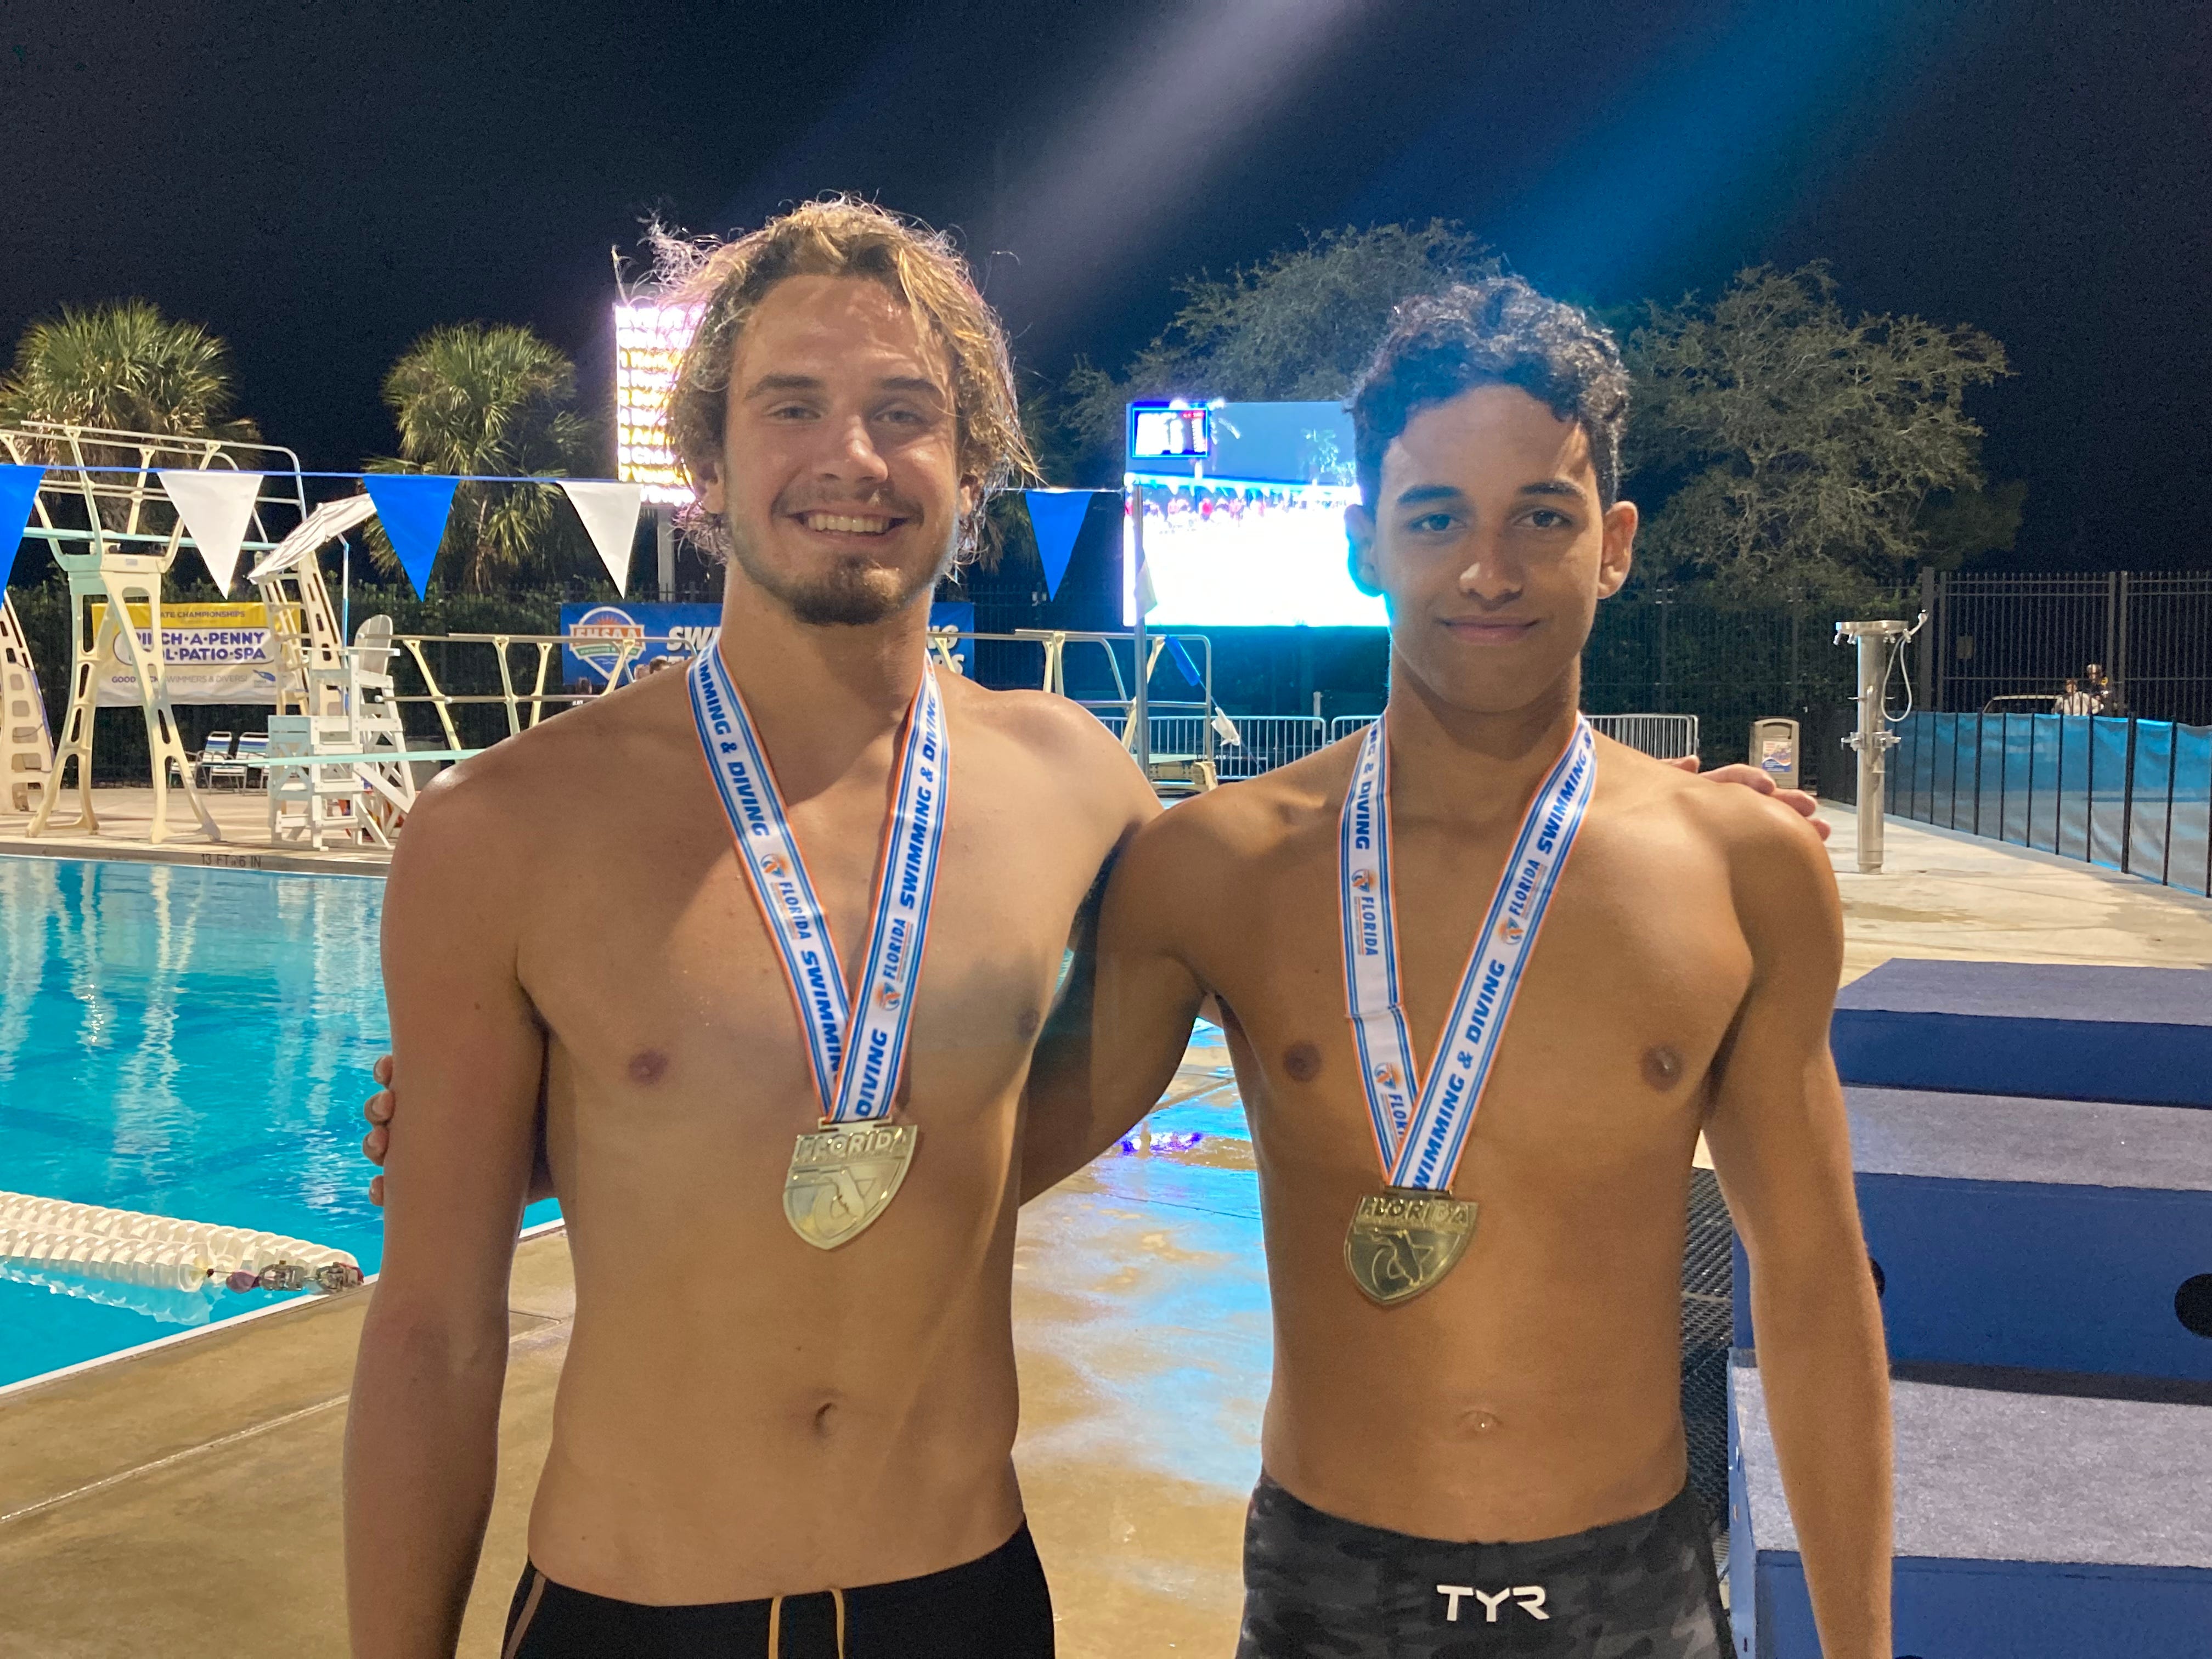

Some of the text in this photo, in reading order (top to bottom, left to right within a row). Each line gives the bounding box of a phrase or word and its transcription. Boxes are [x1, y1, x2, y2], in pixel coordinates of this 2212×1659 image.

[699, 659, 770, 837] IMMING & DIVING
[922, 691, 936, 762] DIVING
[920, 766, 934, 783] &
[1537, 749, 1587, 854] SWIMMING
[899, 786, 932, 910] SWIMMING
[1355, 781, 1372, 850] DIVING
[201, 854, 212, 865] 13
[216, 854, 230, 866] FT
[250, 856, 261, 868] IN
[1509, 859, 1541, 916] FLORIDA
[778, 882, 812, 940] FLORIDA
[1361, 896, 1378, 956] FLORIDA
[883, 918, 906, 980] FLORIDA
[800, 950, 842, 1083] SWIMMIN
[855, 1028, 888, 1117] DIVING
[1413, 959, 1505, 1189] WIMMING & DIVING
[1436, 1584, 1550, 1622] TYR
